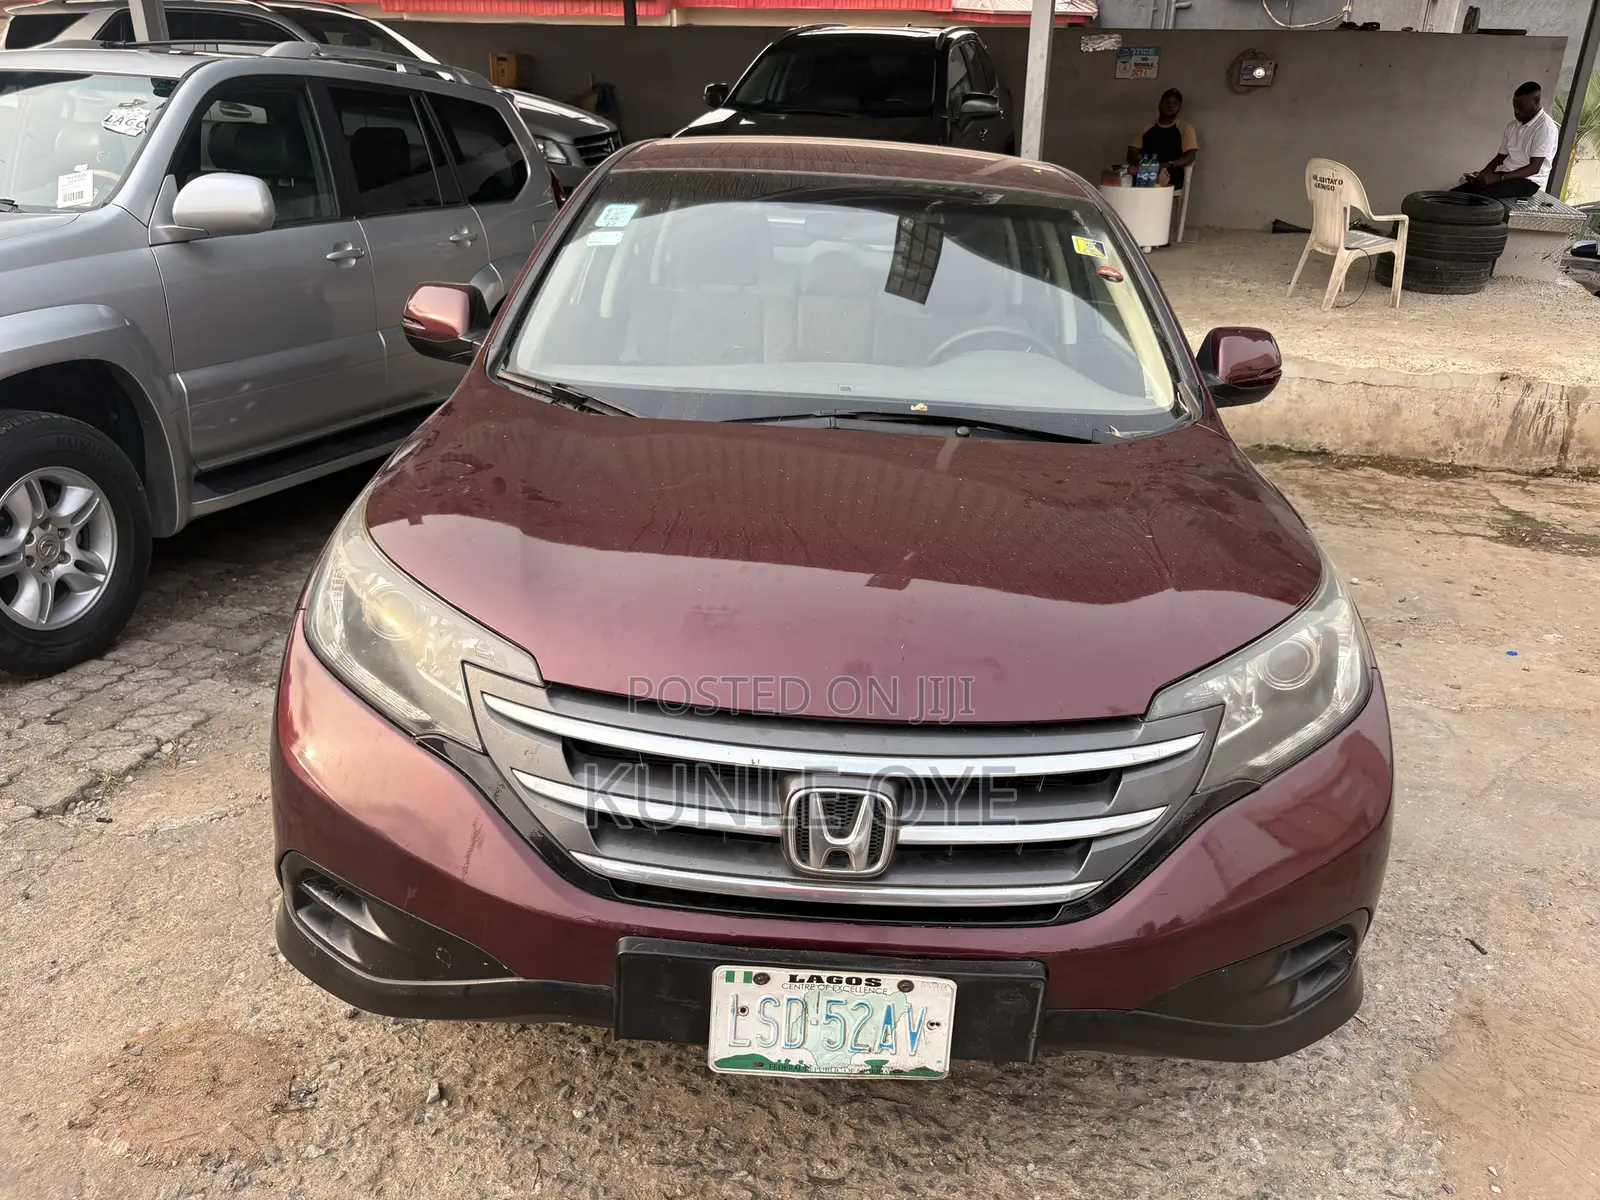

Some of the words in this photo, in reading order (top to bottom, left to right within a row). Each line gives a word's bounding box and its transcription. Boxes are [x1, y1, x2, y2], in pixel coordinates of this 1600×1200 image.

[788, 974, 882, 988] LAGOS
[781, 982, 815, 991] CENTRE
[817, 983, 830, 992] OF
[832, 985, 889, 996] EXCELLENCE
[768, 1063, 802, 1072] FEDERAL
